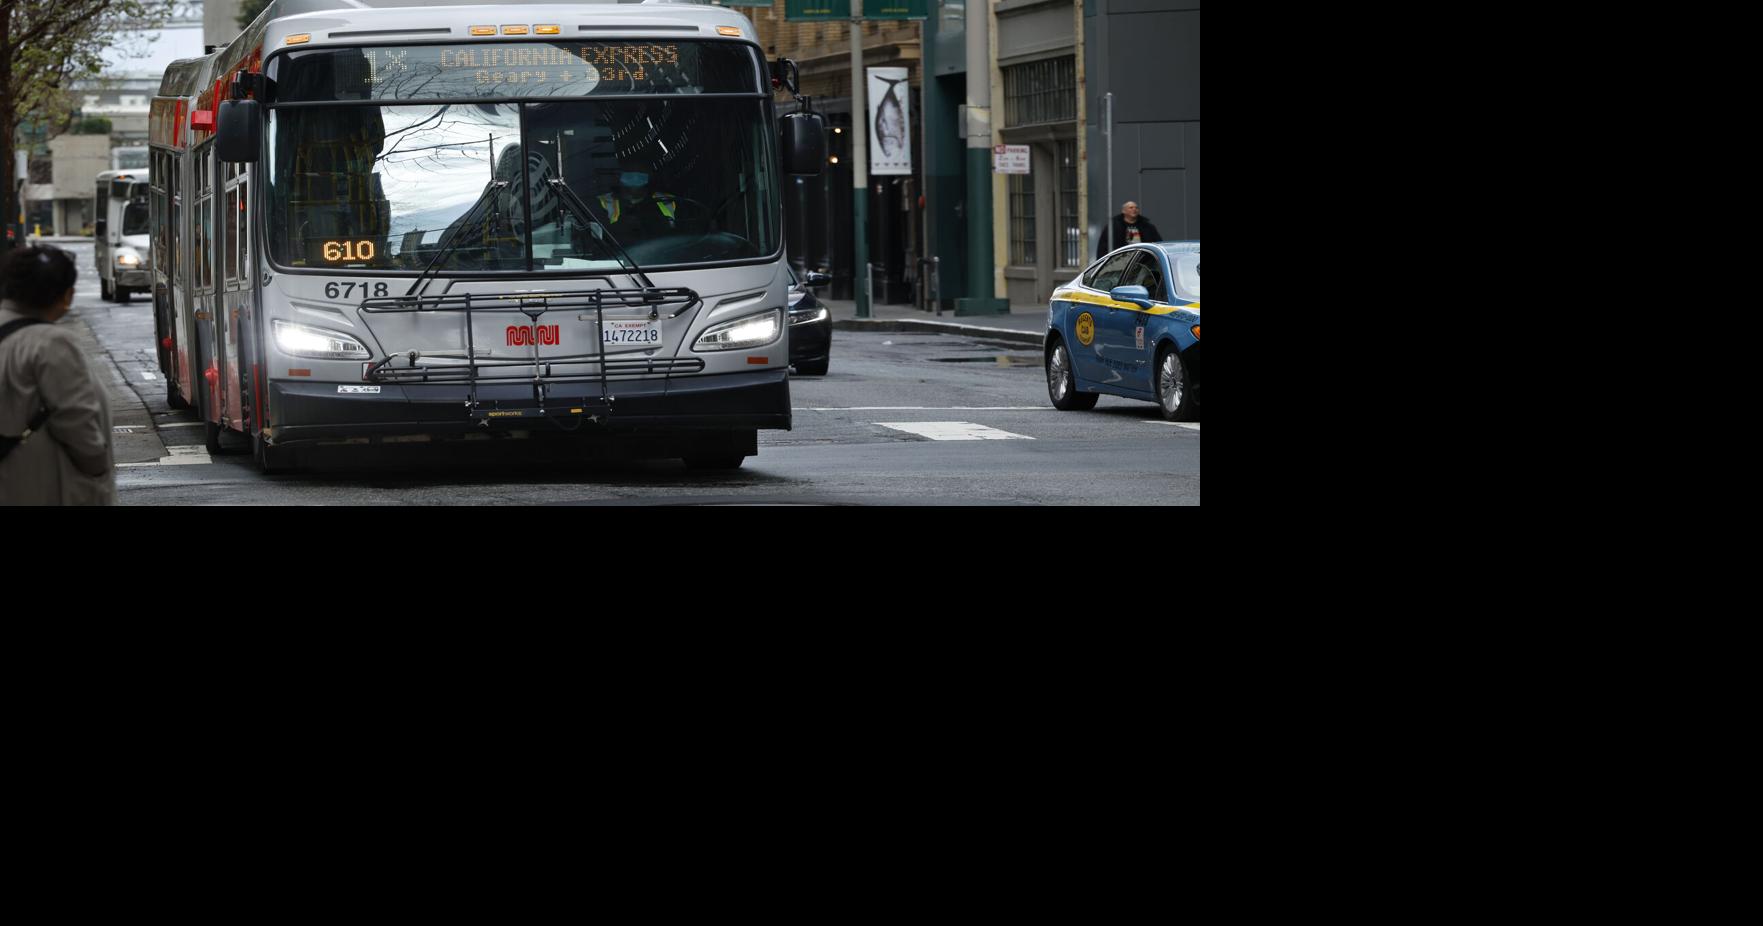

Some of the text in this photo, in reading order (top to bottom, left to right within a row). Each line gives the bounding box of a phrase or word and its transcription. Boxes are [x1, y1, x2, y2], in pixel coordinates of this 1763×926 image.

[441, 47, 572, 67] CALIFORNIA
[581, 45, 678, 65] EXPRESS
[476, 69, 546, 83] Geary
[323, 240, 375, 261] 610
[324, 281, 389, 299] 6718
[603, 329, 658, 343] 1472218
